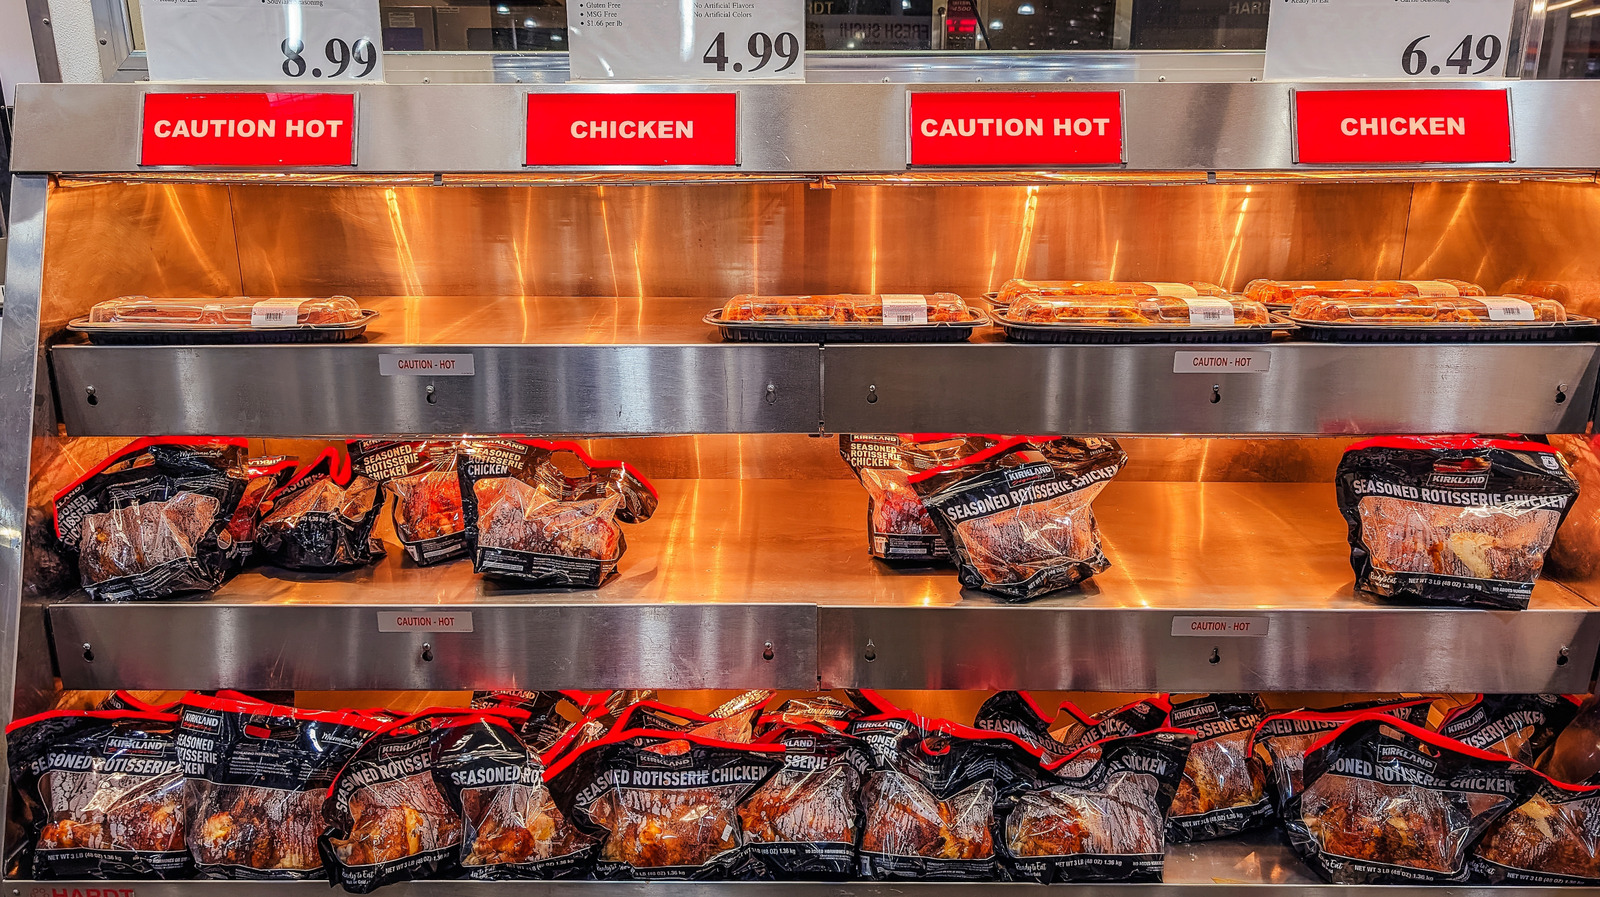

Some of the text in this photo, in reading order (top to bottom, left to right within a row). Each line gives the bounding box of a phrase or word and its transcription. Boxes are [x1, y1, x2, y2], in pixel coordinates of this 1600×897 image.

[281, 38, 377, 79] 8.99
[703, 32, 800, 73] 4.99
[1401, 34, 1502, 76] 6.49
[154, 119, 344, 138] CAUTION HOT
[570, 120, 694, 139] CHICKEN
[920, 118, 1110, 138] CAUTION HOT
[1340, 117, 1466, 136] CHICKEN
[398, 360, 433, 369] CAUTION
[440, 360, 456, 369] HOT
[1192, 357, 1228, 367] CAUTION
[1234, 357, 1252, 367] HOT
[854, 434, 897, 442] KIRKLAND
[364, 444, 412, 466] SEASONED
[850, 443, 897, 454] SEASONED
[850, 450, 902, 462] ROTISSERIE
[365, 453, 419, 475] ROTISSERIE
[851, 457, 890, 467] CHICKEN
[468, 464, 508, 476] CHICKEN
[1009, 466, 1052, 481] KIRKLAND
[1432, 475, 1486, 485] KIRKLAND
[947, 464, 1119, 521] SEASONED ROTISSERIE CHICKEN
[1353, 479, 1568, 509] SEASONED ROTISSERIE CHICKEN
[396, 616, 432, 626] CAUTION
[438, 617, 455, 626] HOT
[1190, 622, 1227, 631] CAUTION
[1234, 622, 1250, 631] HOT
[184, 712, 219, 727] KIRKLAND
[1174, 705, 1215, 721] KIRKLAND
[856, 721, 903, 730] KIRKLAND
[1194, 719, 1240, 740] ISSERIE
[1448, 711, 1484, 734] KIRKLAND
[108, 738, 164, 751] KIRKLAND
[382, 736, 430, 754] KIRKLAND
[177, 747, 218, 765] TISSERIE
[640, 755, 691, 767] KIRKLAND
[1381, 747, 1434, 769] KIRKLAND
[380, 752, 432, 779] ROTISSE
[450, 766, 521, 786] SEASONED
[633, 770, 708, 786] ROTISSERIE
[712, 766, 768, 783] CHICKEN
[1375, 765, 1449, 788] ROTISSERIE
[1450, 776, 1516, 794] CHICKEN
[1182, 820, 1192, 828] NET
[386, 866, 396, 874] NET
[396, 864, 405, 872] WT
[1015, 862, 1031, 873] Ready
[1036, 861, 1047, 871] Eat
[1094, 858, 1103, 866] OZ)
[362, 870, 375, 880] Eat
[1354, 864, 1366, 872] NET
[1402, 870, 1412, 879] OZ)
